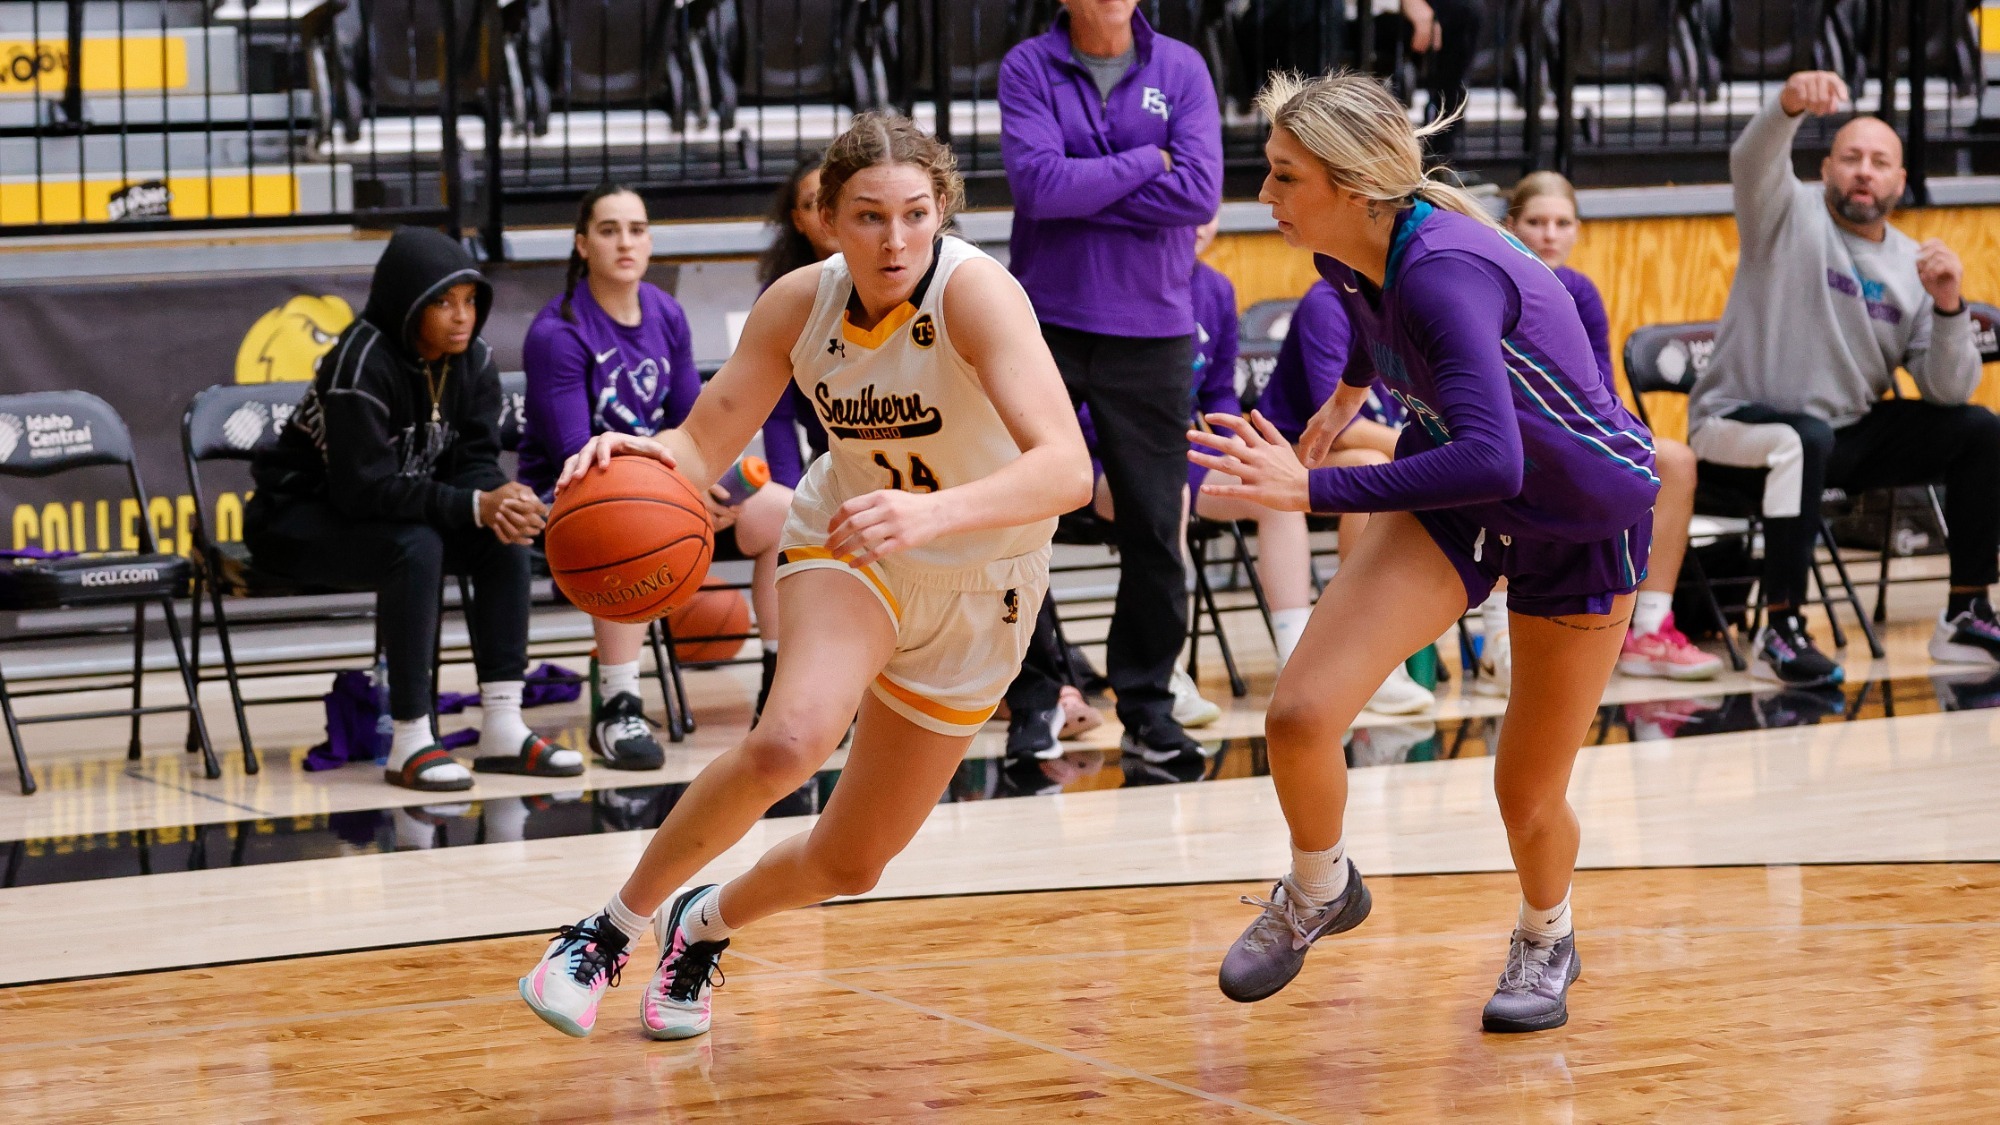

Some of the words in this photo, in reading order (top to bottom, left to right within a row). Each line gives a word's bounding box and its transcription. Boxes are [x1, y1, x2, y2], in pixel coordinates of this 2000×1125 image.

[916, 321, 935, 342] TS
[815, 382, 940, 427] Southern
[25, 413, 74, 432] Idaho
[28, 428, 92, 448] Central
[857, 426, 901, 440] IDAHO
[81, 567, 159, 587] iccu.com
[571, 563, 675, 606] SPALDING
